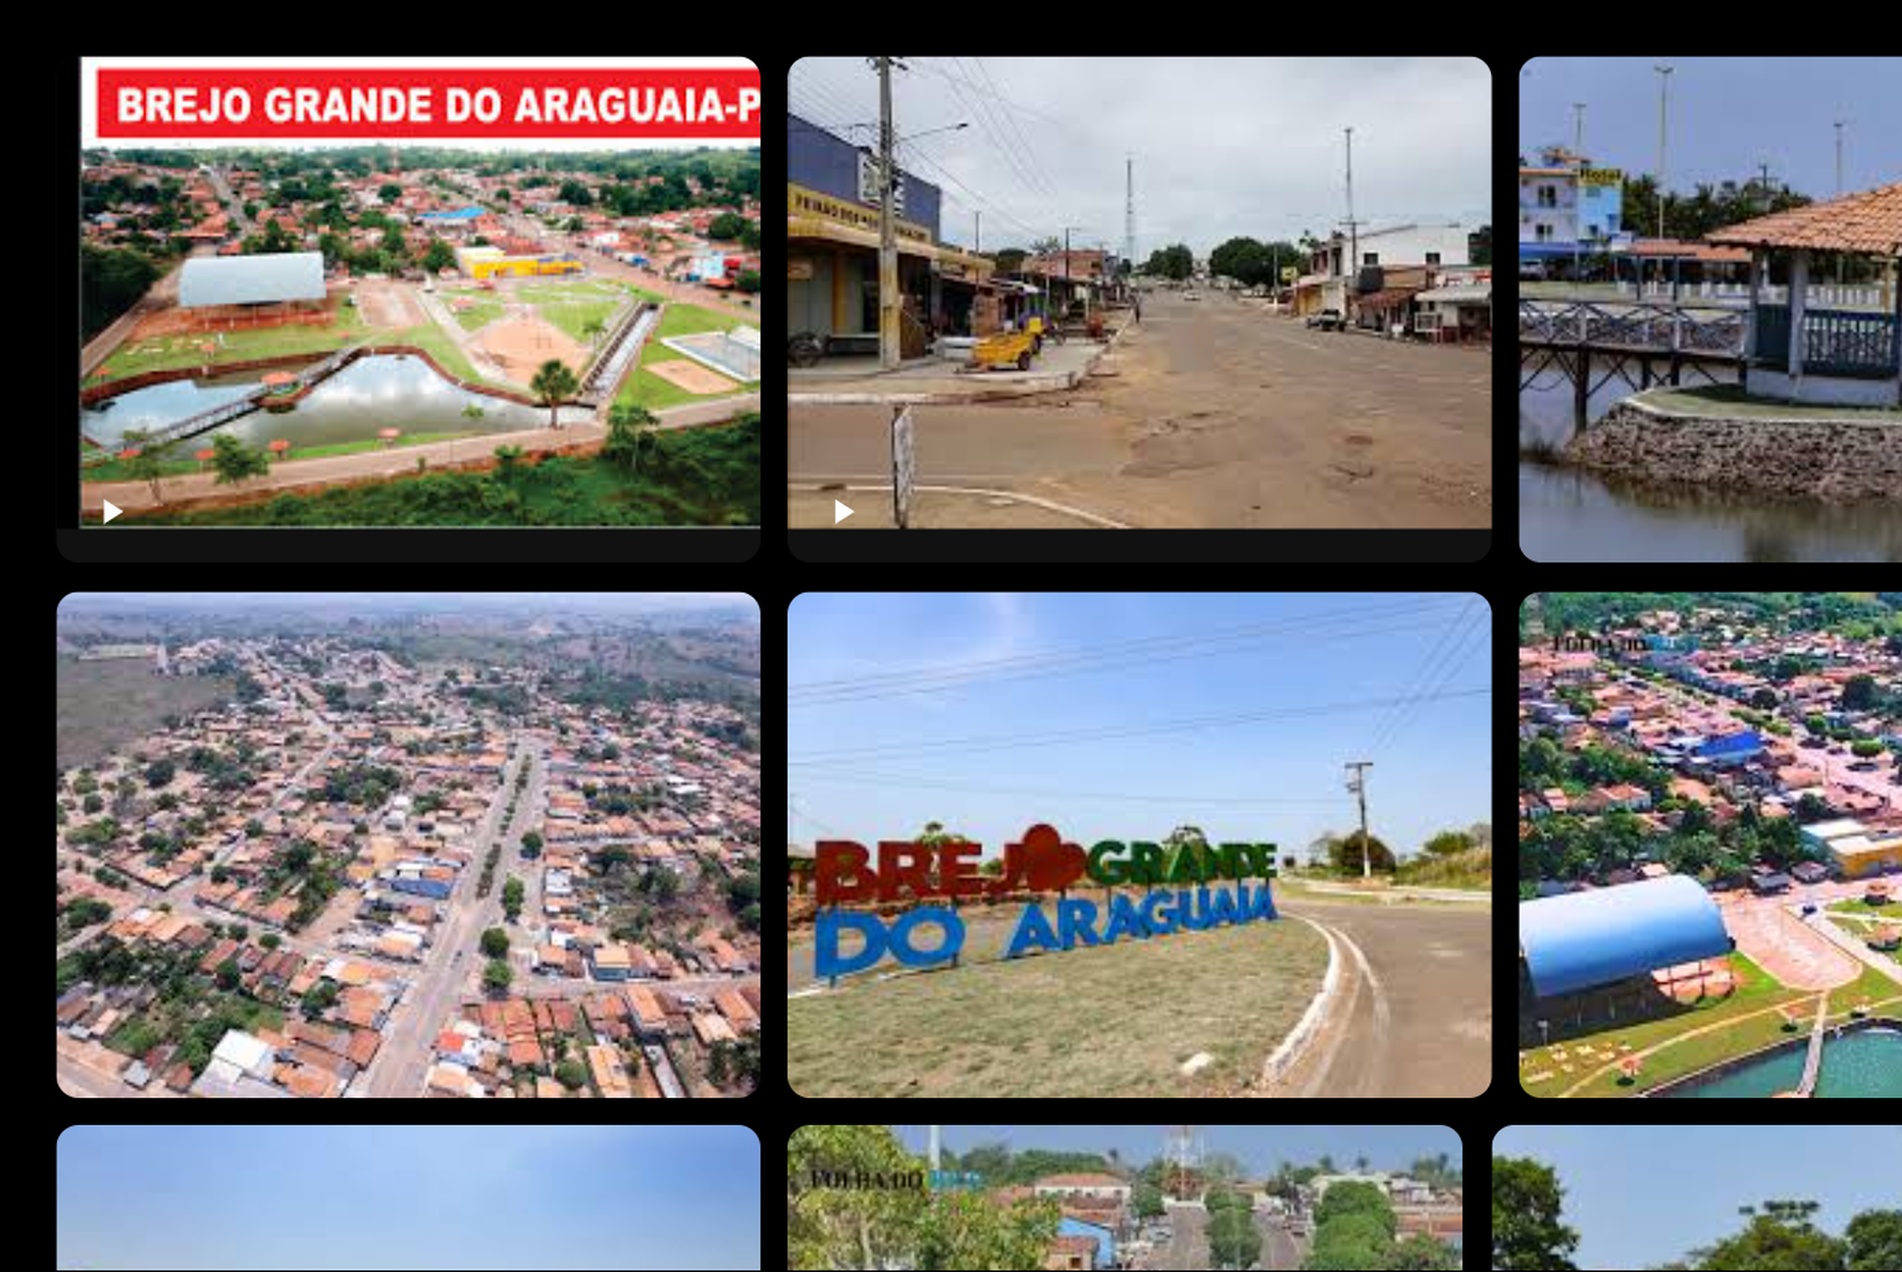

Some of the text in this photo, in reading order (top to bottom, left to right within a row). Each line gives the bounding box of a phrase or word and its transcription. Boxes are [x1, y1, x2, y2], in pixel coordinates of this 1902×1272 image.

[1087, 840, 1278, 886] GRANDE
[815, 881, 1279, 980] DO ARAGUAIA
